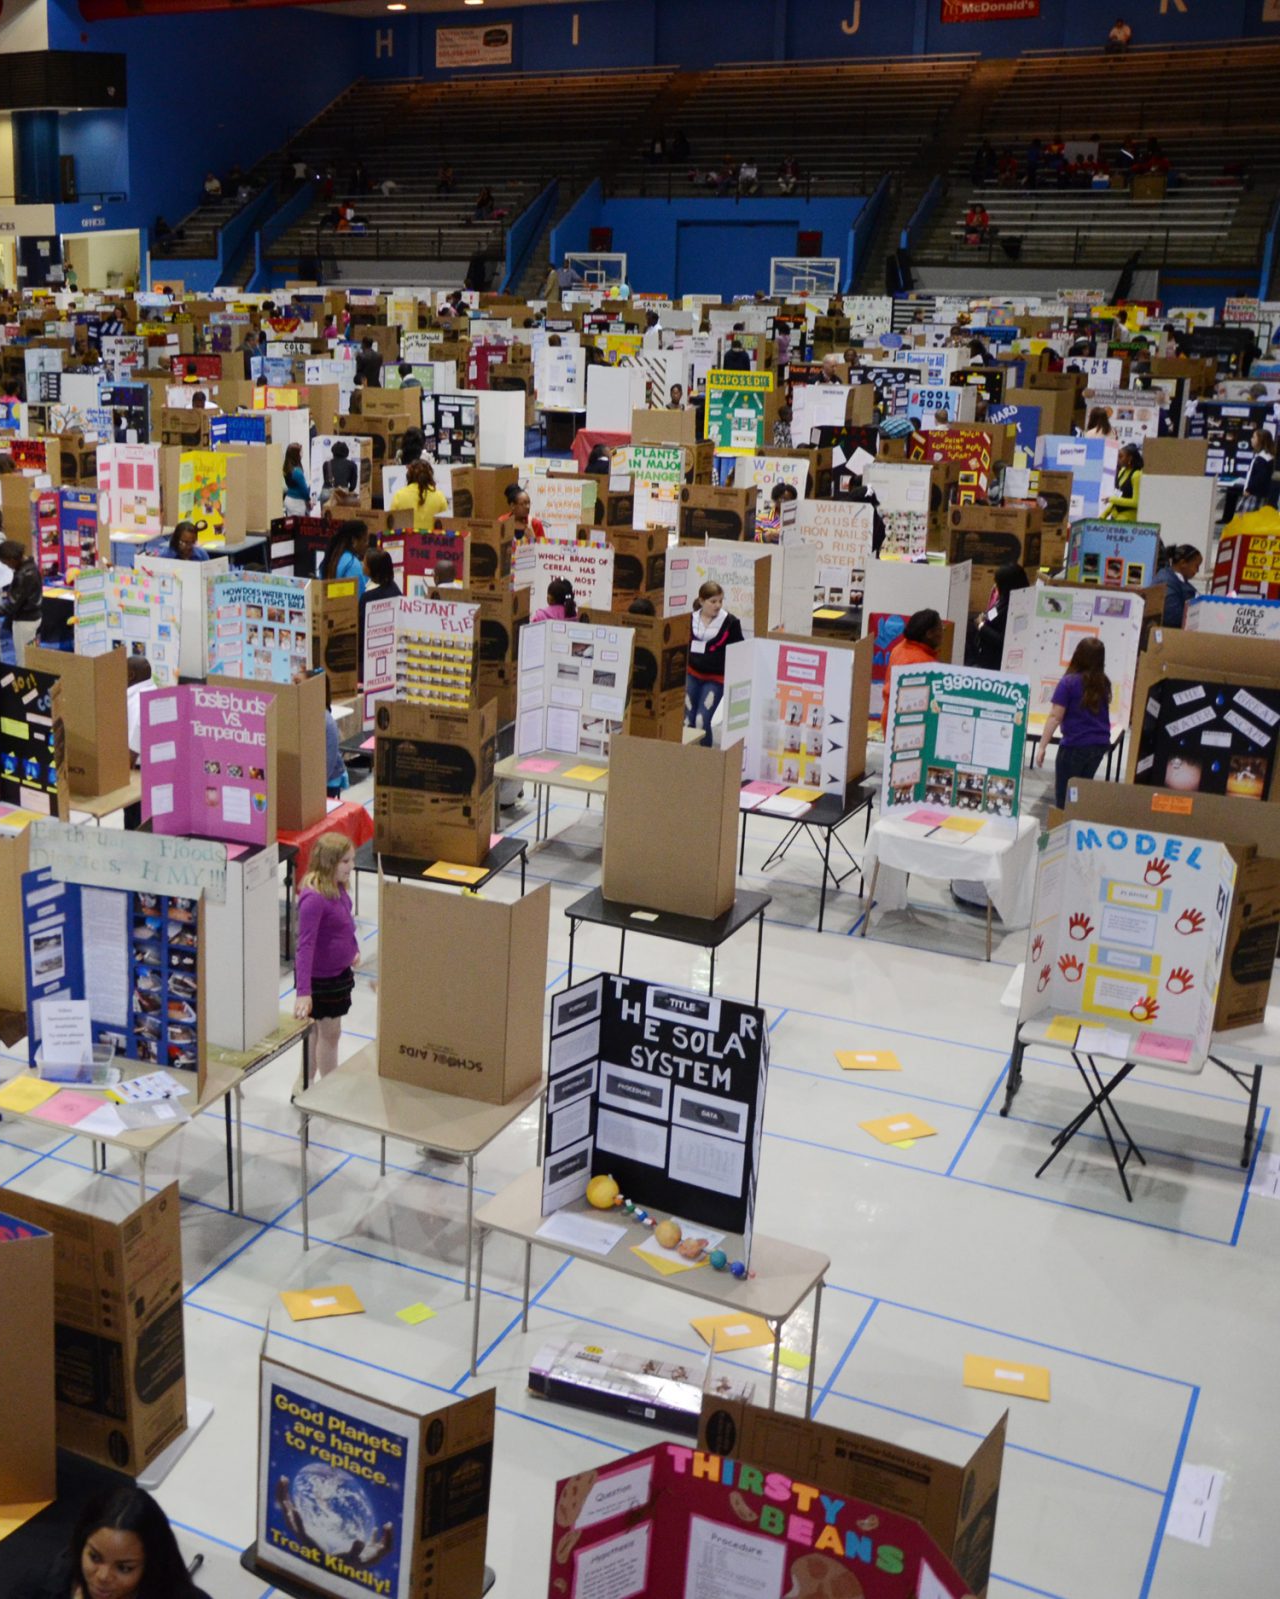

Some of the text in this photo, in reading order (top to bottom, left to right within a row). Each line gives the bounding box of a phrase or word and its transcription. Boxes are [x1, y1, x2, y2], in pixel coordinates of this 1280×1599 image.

[962, 0, 1034, 13] McDonald's
[376, 29, 393, 57] H
[711, 374, 768, 386] EXPOSED!!
[920, 390, 950, 400] COOL
[919, 399, 951, 410] SODA
[634, 448, 679, 459] PLANTS
[628, 459, 641, 468] IN
[753, 459, 797, 471] Water
[816, 503, 854, 513] WHAT
[814, 516, 868, 527] CAUSES
[800, 526, 868, 541] IRON NAILS
[832, 541, 865, 553] RUST
[409, 548, 429, 560] THE
[538, 553, 564, 561] WHICH
[570, 555, 596, 564] BRAND
[1252, 555, 1267, 565] to
[543, 563, 572, 571] CEREAL
[1245, 569, 1268, 580] not
[575, 577, 596, 586] MOST
[222, 588, 241, 597] HOW
[242, 588, 261, 597] DOES
[400, 599, 457, 617] INSTANT
[1237, 607, 1264, 618] GIRLS
[1235, 617, 1259, 627] RULE
[932, 674, 1026, 710] Eggonomics
[1168, 710, 1213, 732] WATER
[190, 720, 266, 747] Temperature
[1076, 828, 1202, 870] MODEL
[670, 998, 696, 1012] TITLE
[672, 1013, 757, 1059] SOLAR
[399, 1044, 482, 1072] SCHOOL AIDS
[631, 1045, 732, 1092] SYSTEM
[701, 1109, 718, 1120] DATA
[275, 1394, 402, 1457] Good Planets
[294, 1421, 376, 1465] are hard
[285, 1432, 391, 1486] to replace.
[667, 1445, 846, 1524] THIRSTY
[595, 1484, 632, 1502] Question
[711, 1533, 763, 1555] Procedure
[759, 1505, 904, 1574] BEANS
[590, 1540, 635, 1564] Hypothesis
[271, 1528, 391, 1594] Treat Kindly!
